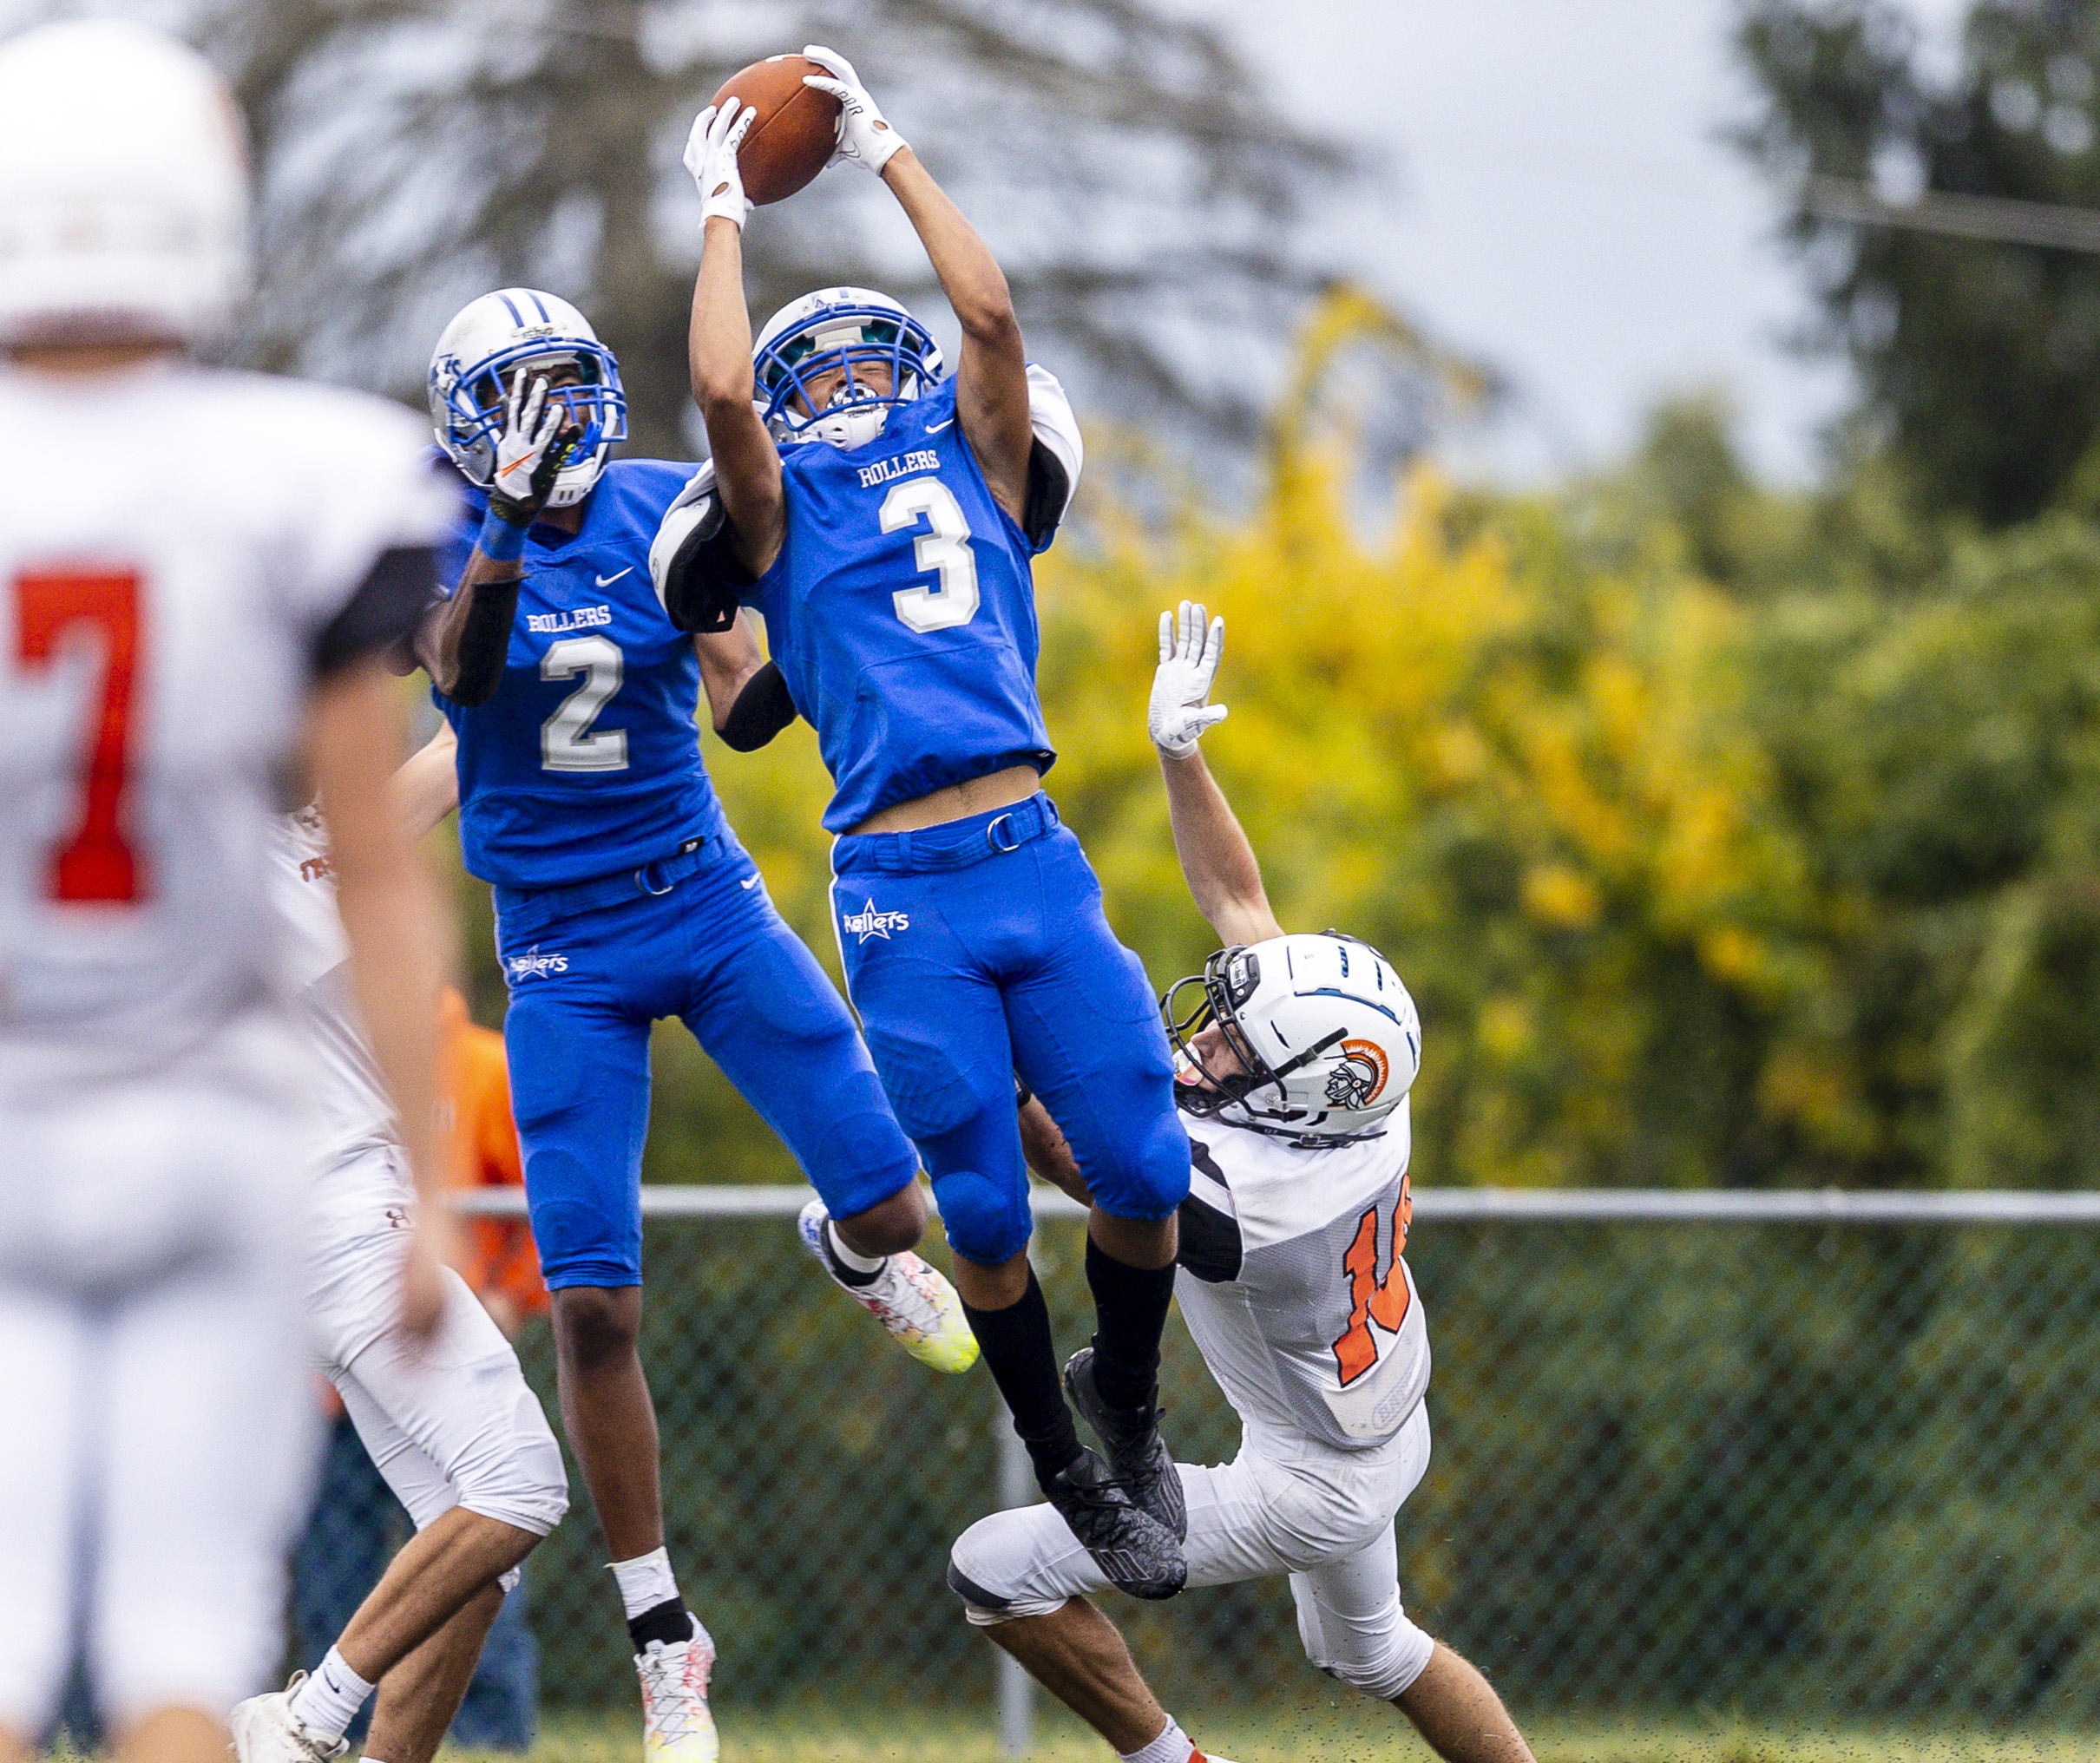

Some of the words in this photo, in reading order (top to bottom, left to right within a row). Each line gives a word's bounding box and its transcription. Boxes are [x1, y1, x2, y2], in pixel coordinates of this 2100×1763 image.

[856, 449, 941, 488] ROLLERS
[526, 604, 612, 632] ROLLERS
[878, 475, 981, 634] 3
[14, 573, 139, 904] 7
[539, 634, 630, 772] 2
